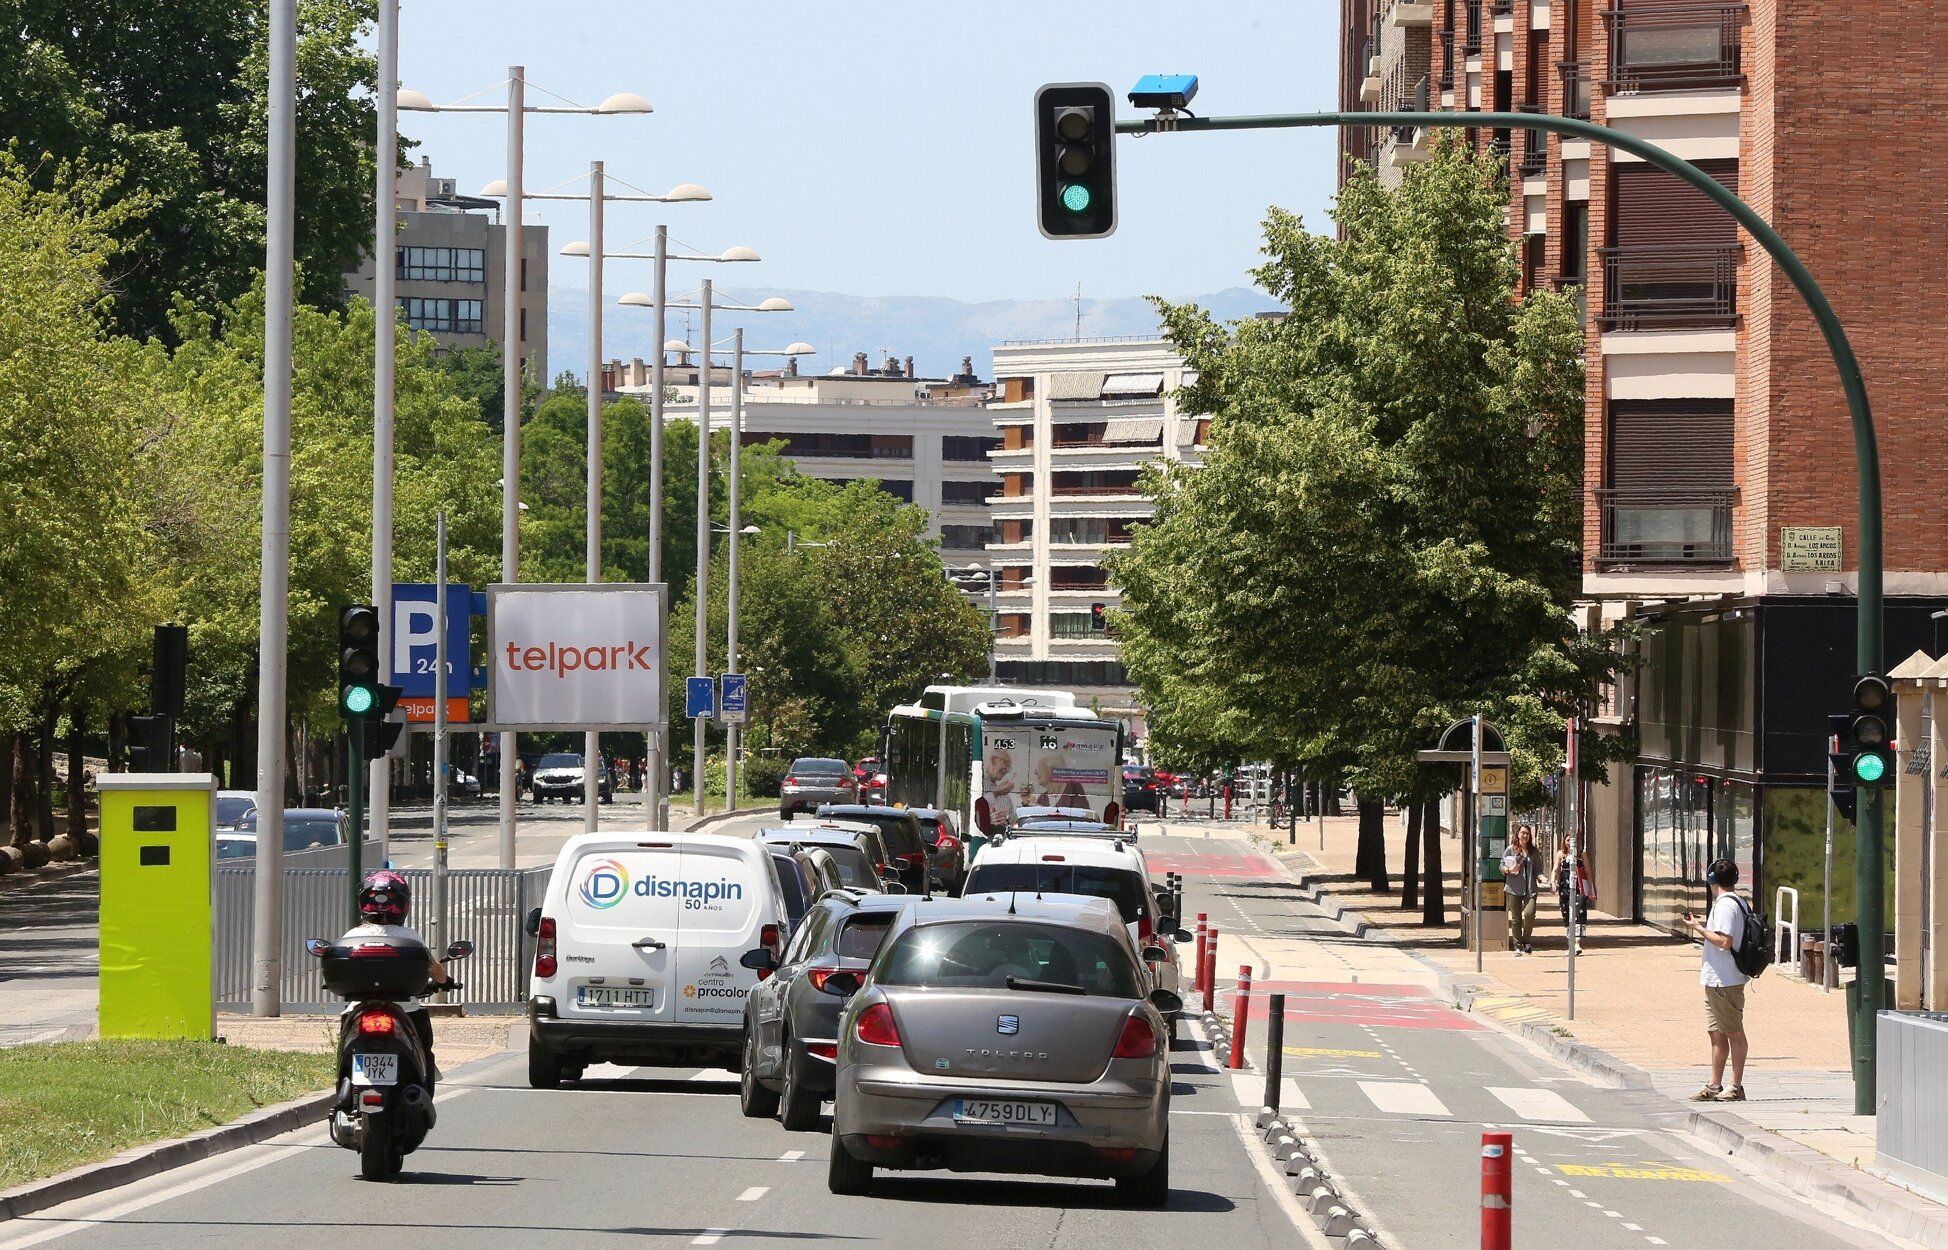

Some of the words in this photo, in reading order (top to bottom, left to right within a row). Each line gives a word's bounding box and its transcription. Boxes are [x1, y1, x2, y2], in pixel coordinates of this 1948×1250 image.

[394, 600, 449, 674] P
[506, 640, 652, 678] telpark
[398, 703, 450, 718] elpak
[994, 738, 1016, 750] 453
[633, 874, 742, 905] disnapin
[684, 899, 701, 910] 50
[698, 978, 724, 987] centro
[588, 989, 619, 1003] 1711
[624, 990, 650, 1004] HTT
[697, 986, 749, 999] procolor
[966, 1048, 1048, 1060] TOLEDO
[364, 1056, 394, 1068] 0344
[365, 1067, 386, 1079] JYK
[966, 1101, 1051, 1122] 4759DLY
